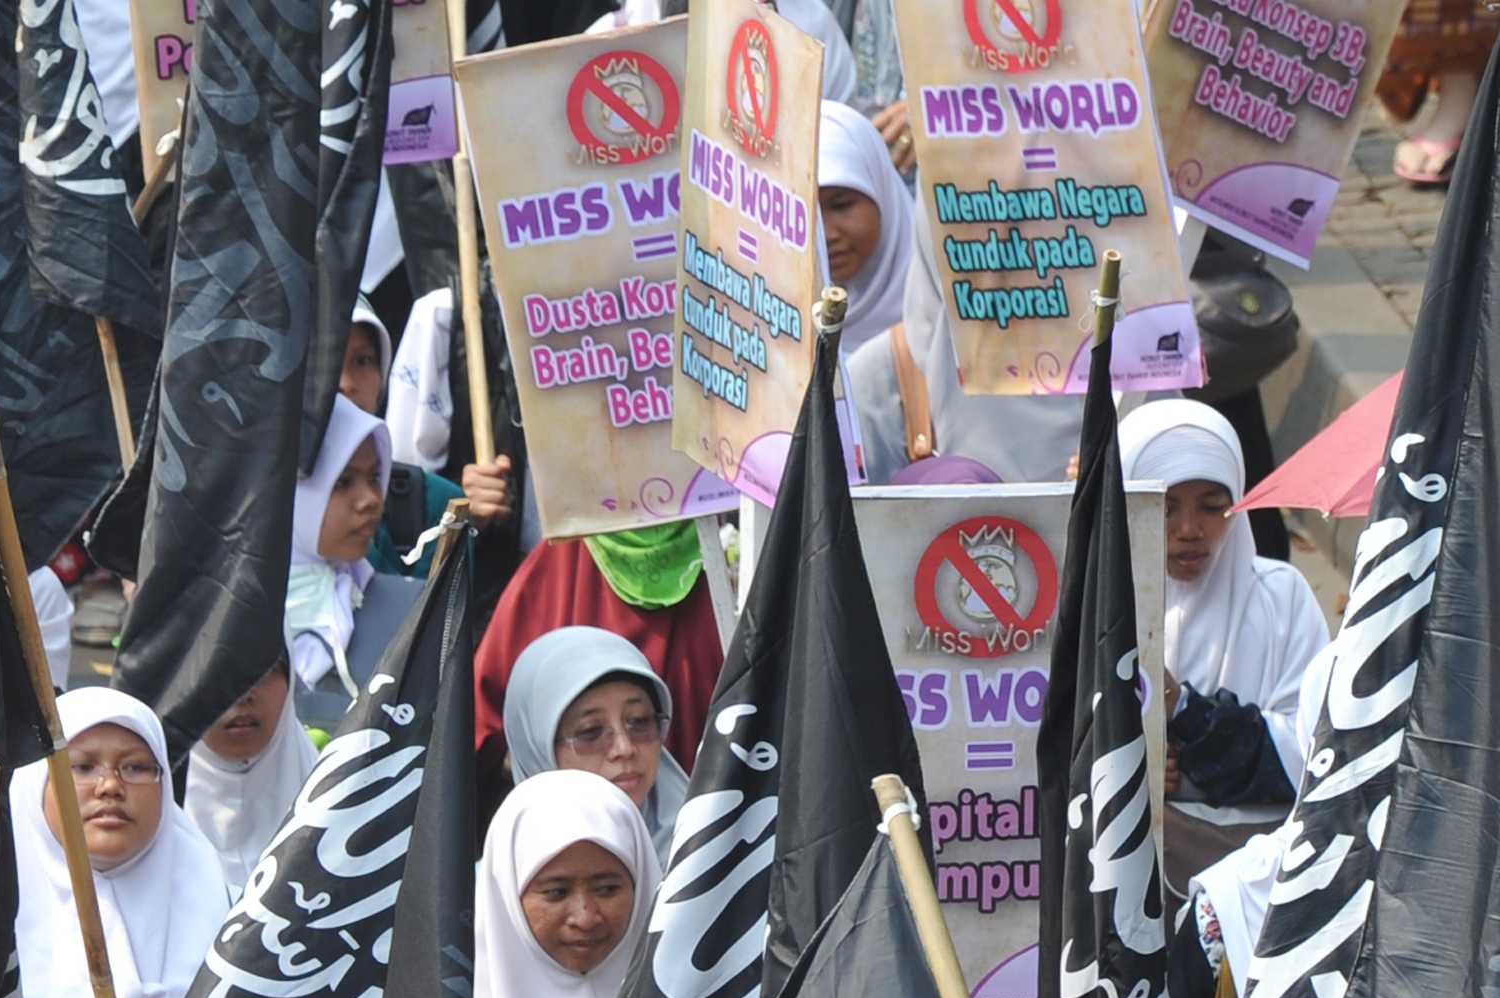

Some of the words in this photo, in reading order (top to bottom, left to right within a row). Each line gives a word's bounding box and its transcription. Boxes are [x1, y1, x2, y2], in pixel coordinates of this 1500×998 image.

[1169, 0, 1234, 66] Brain,
[1233, 28, 1313, 104] Beauty
[1308, 73, 1358, 118] and
[1328, 21, 1365, 75] 3B,
[923, 86, 1005, 135] MISS
[1007, 81, 1139, 135] WORLD
[1196, 64, 1296, 143] Behavior
[501, 186, 610, 244] MISS
[690, 132, 735, 204] MISS
[739, 161, 808, 249] WORLD
[933, 179, 1057, 224] Membawa
[1056, 178, 1147, 228] Negara
[944, 226, 1034, 272] tunduk
[1032, 225, 1097, 279] pada
[524, 288, 621, 337] Dusta
[684, 229, 750, 311] Membawa
[752, 272, 801, 342] Negara
[953, 275, 1070, 330] Korporasi
[531, 336, 628, 388] Brain,
[628, 328, 674, 371] Be
[683, 285, 732, 350] tunduk
[732, 322, 766, 373] pada
[682, 331, 748, 412] Korporasi
[607, 377, 673, 426] Beh
